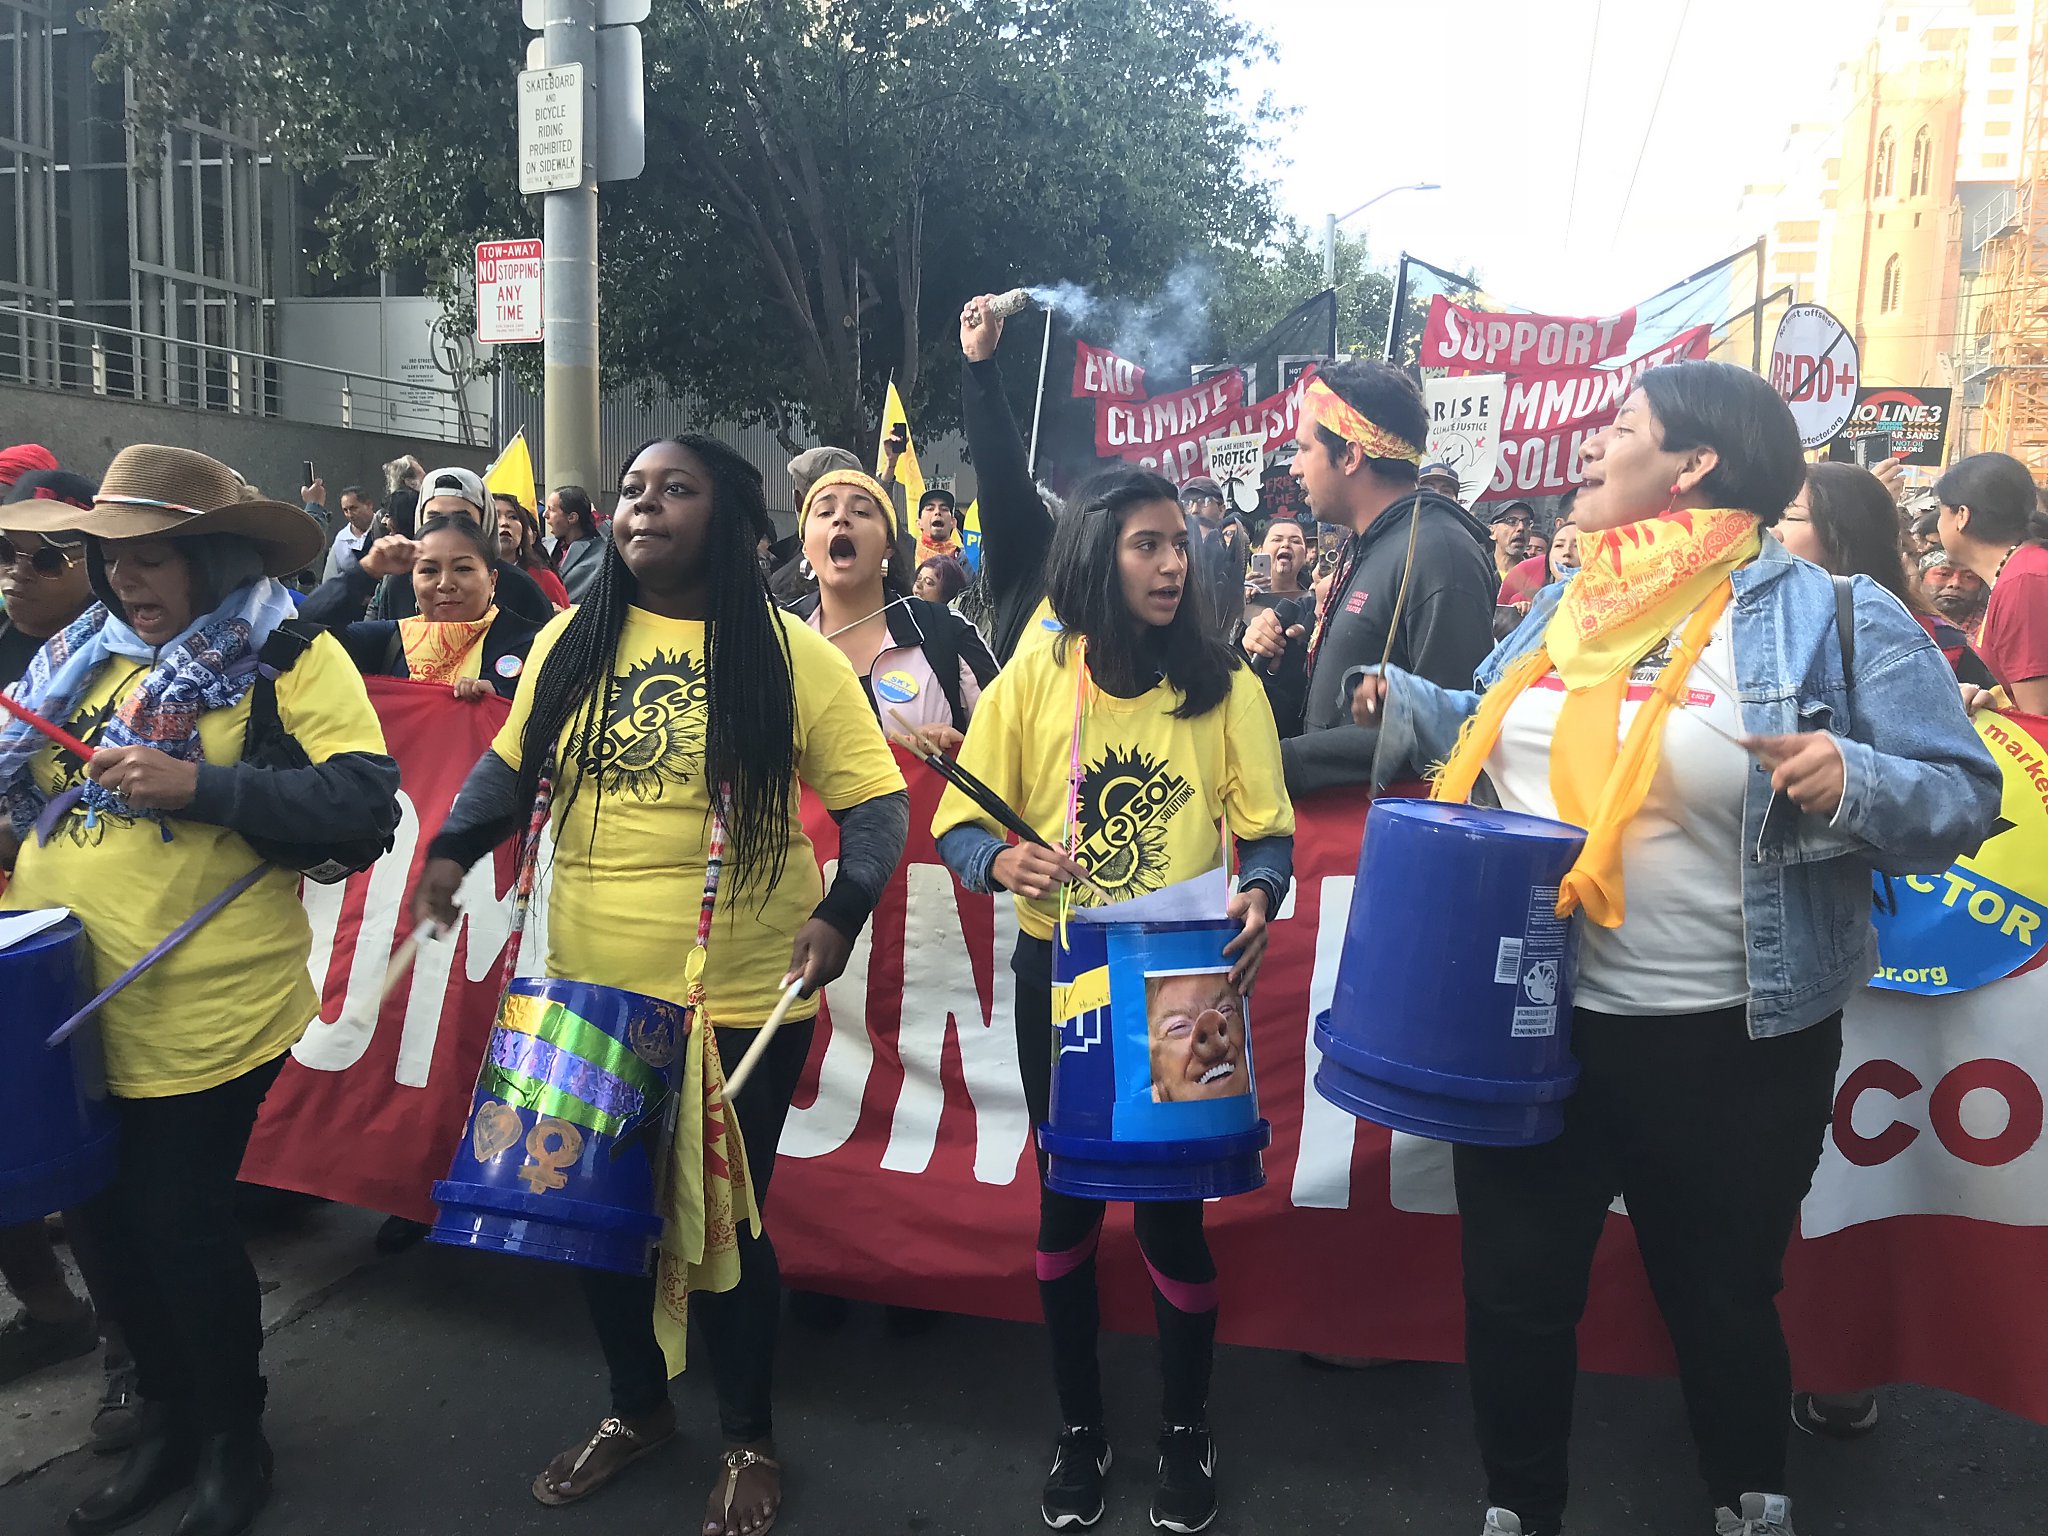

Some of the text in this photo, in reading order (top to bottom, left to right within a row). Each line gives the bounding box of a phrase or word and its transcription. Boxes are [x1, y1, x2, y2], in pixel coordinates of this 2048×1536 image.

[526, 73, 576, 93] SKATEBOARD
[545, 93, 557, 103] AND
[535, 105, 566, 121] BICYCLE
[538, 123, 564, 138] RIDING
[529, 139, 573, 157] PROHIBITED
[526, 156, 576, 175] ON SIDEWALK
[482, 244, 536, 258] TOW-AWAY
[479, 260, 539, 282] NO STOPPING
[497, 285, 522, 302] ANY
[496, 304, 524, 321] TIME
[1805, 308, 1836, 329] offsets!
[1438, 307, 1622, 366] SUPPORT
[1084, 351, 1135, 396] END
[1772, 351, 1855, 403] REDD+
[1107, 375, 1230, 446] CLIMATE
[1434, 395, 1489, 421] RISE
[1880, 405, 1942, 423] LINE3
[1433, 422, 1487, 435] CLIMAE JUSTICE
[1800, 416, 1844, 445] otector.org
[1839, 431, 1854, 439] NO
[1906, 432, 1940, 440] SANDS
[1224, 443, 1233, 451] ARE
[1233, 441, 1245, 450] HERE
[1245, 440, 1253, 448] TO
[1212, 448, 1259, 469] PROTECT
[891, 676, 911, 688] SKY
[640, 707, 660, 727] 2
[666, 682, 709, 712] SO
[1160, 784, 1196, 824] SOLUTIONS
[1074, 842, 1113, 873] OL
[1111, 818, 1129, 842] 2
[1130, 771, 1185, 822] SOL
[1873, 965, 1949, 987] or.org
